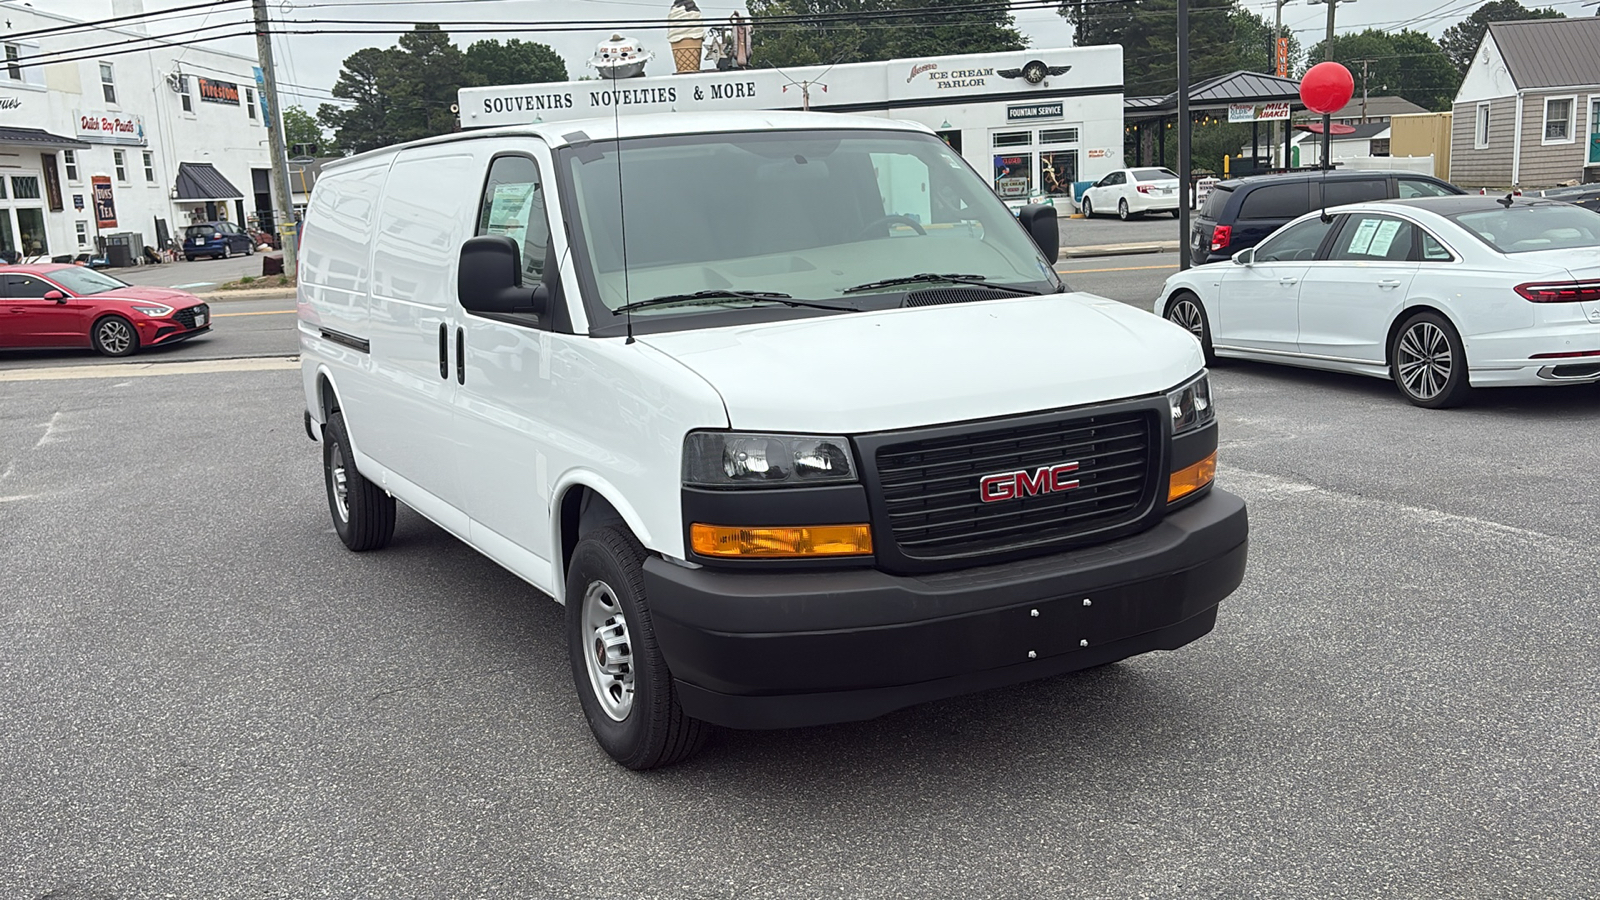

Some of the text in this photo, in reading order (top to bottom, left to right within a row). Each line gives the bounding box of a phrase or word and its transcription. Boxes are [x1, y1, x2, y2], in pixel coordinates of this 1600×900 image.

[929, 68, 994, 80] ICE CREAM
[199, 79, 239, 101] Firestone
[937, 78, 985, 89] PARLOR
[483, 82, 756, 114] SOUVENIRS NOVELTIES & MORE
[1009, 105, 1061, 117] FOUNTAIN SERVICE
[1265, 102, 1289, 111] MILK
[1259, 110, 1288, 119] SHAKES
[81, 115, 134, 134] Dutch Boy Paints
[99, 205, 114, 219] TEA
[980, 461, 1080, 502] GMC
